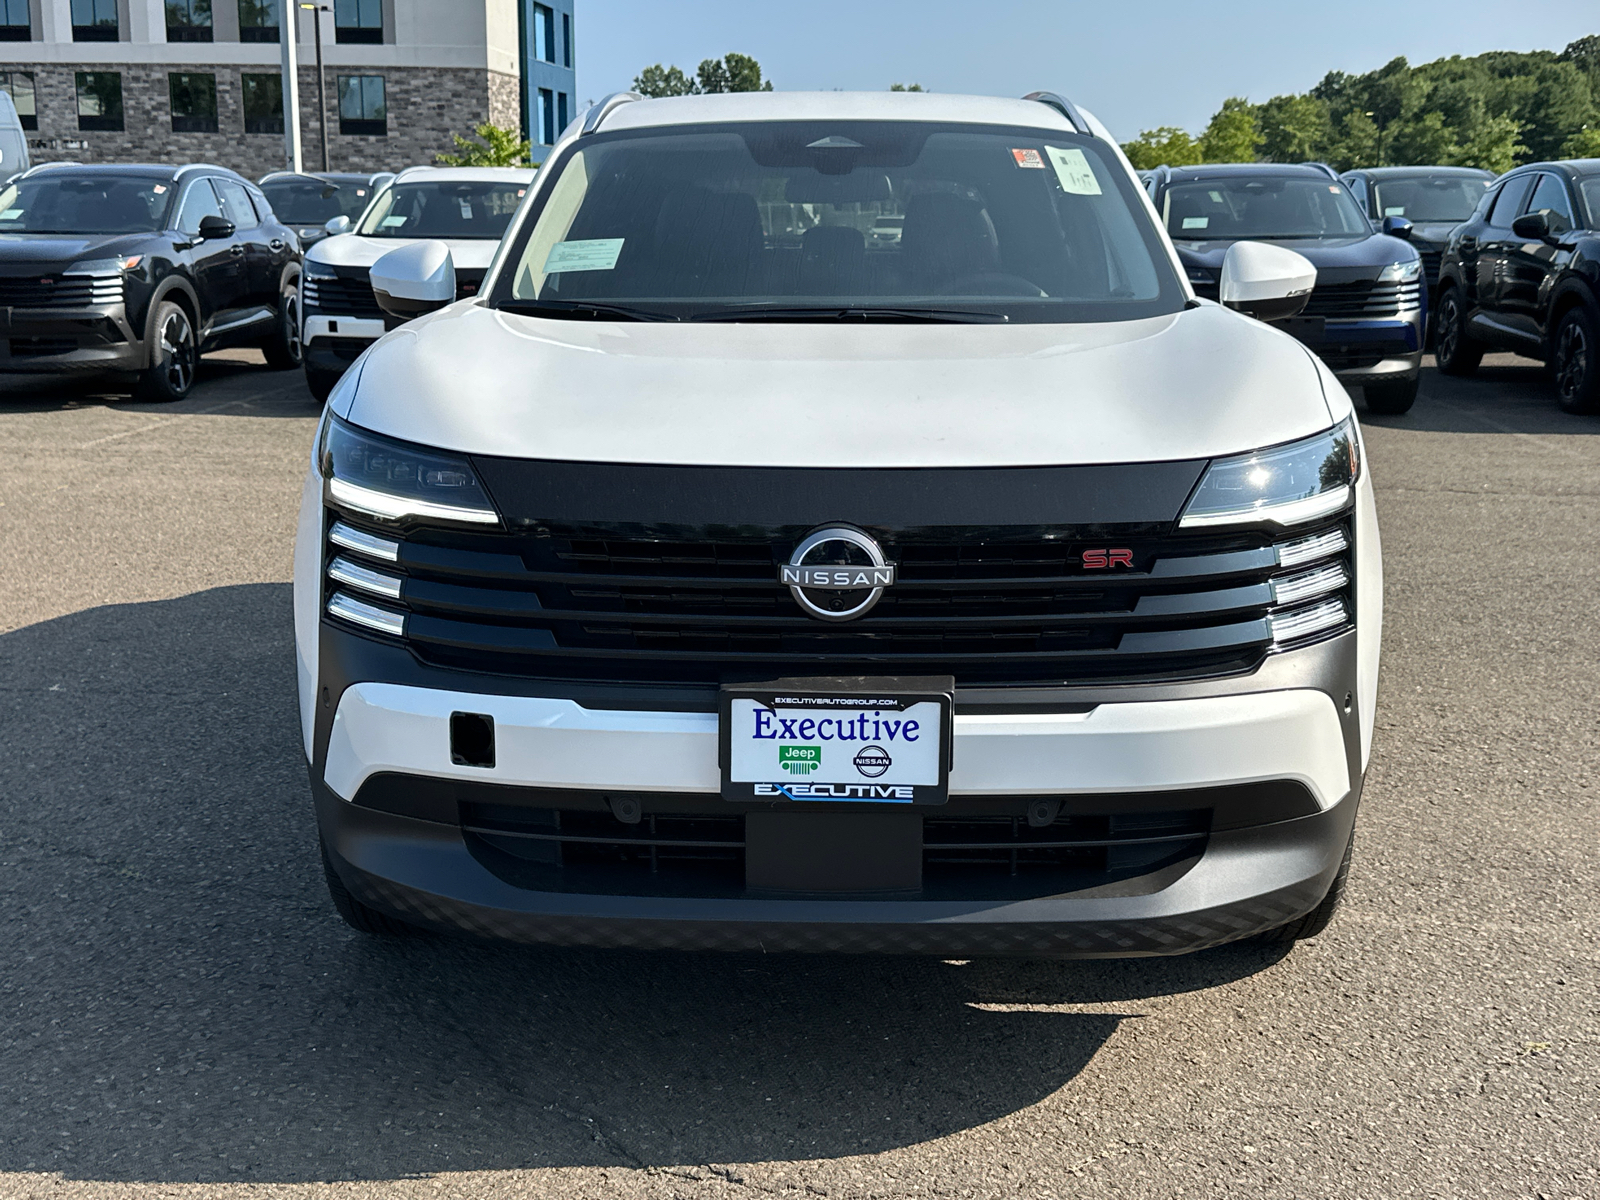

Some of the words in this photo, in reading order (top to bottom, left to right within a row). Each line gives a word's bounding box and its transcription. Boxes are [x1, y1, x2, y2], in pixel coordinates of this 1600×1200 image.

[1082, 548, 1134, 569] SR
[783, 568, 890, 586] NISSAN
[774, 697, 898, 706] EXECUTIVEAUTOGROUP.COM
[752, 708, 920, 742] Executive
[785, 747, 815, 759] Jeep
[855, 758, 890, 766] NISSAN
[754, 783, 914, 799] EXECUTIVE
